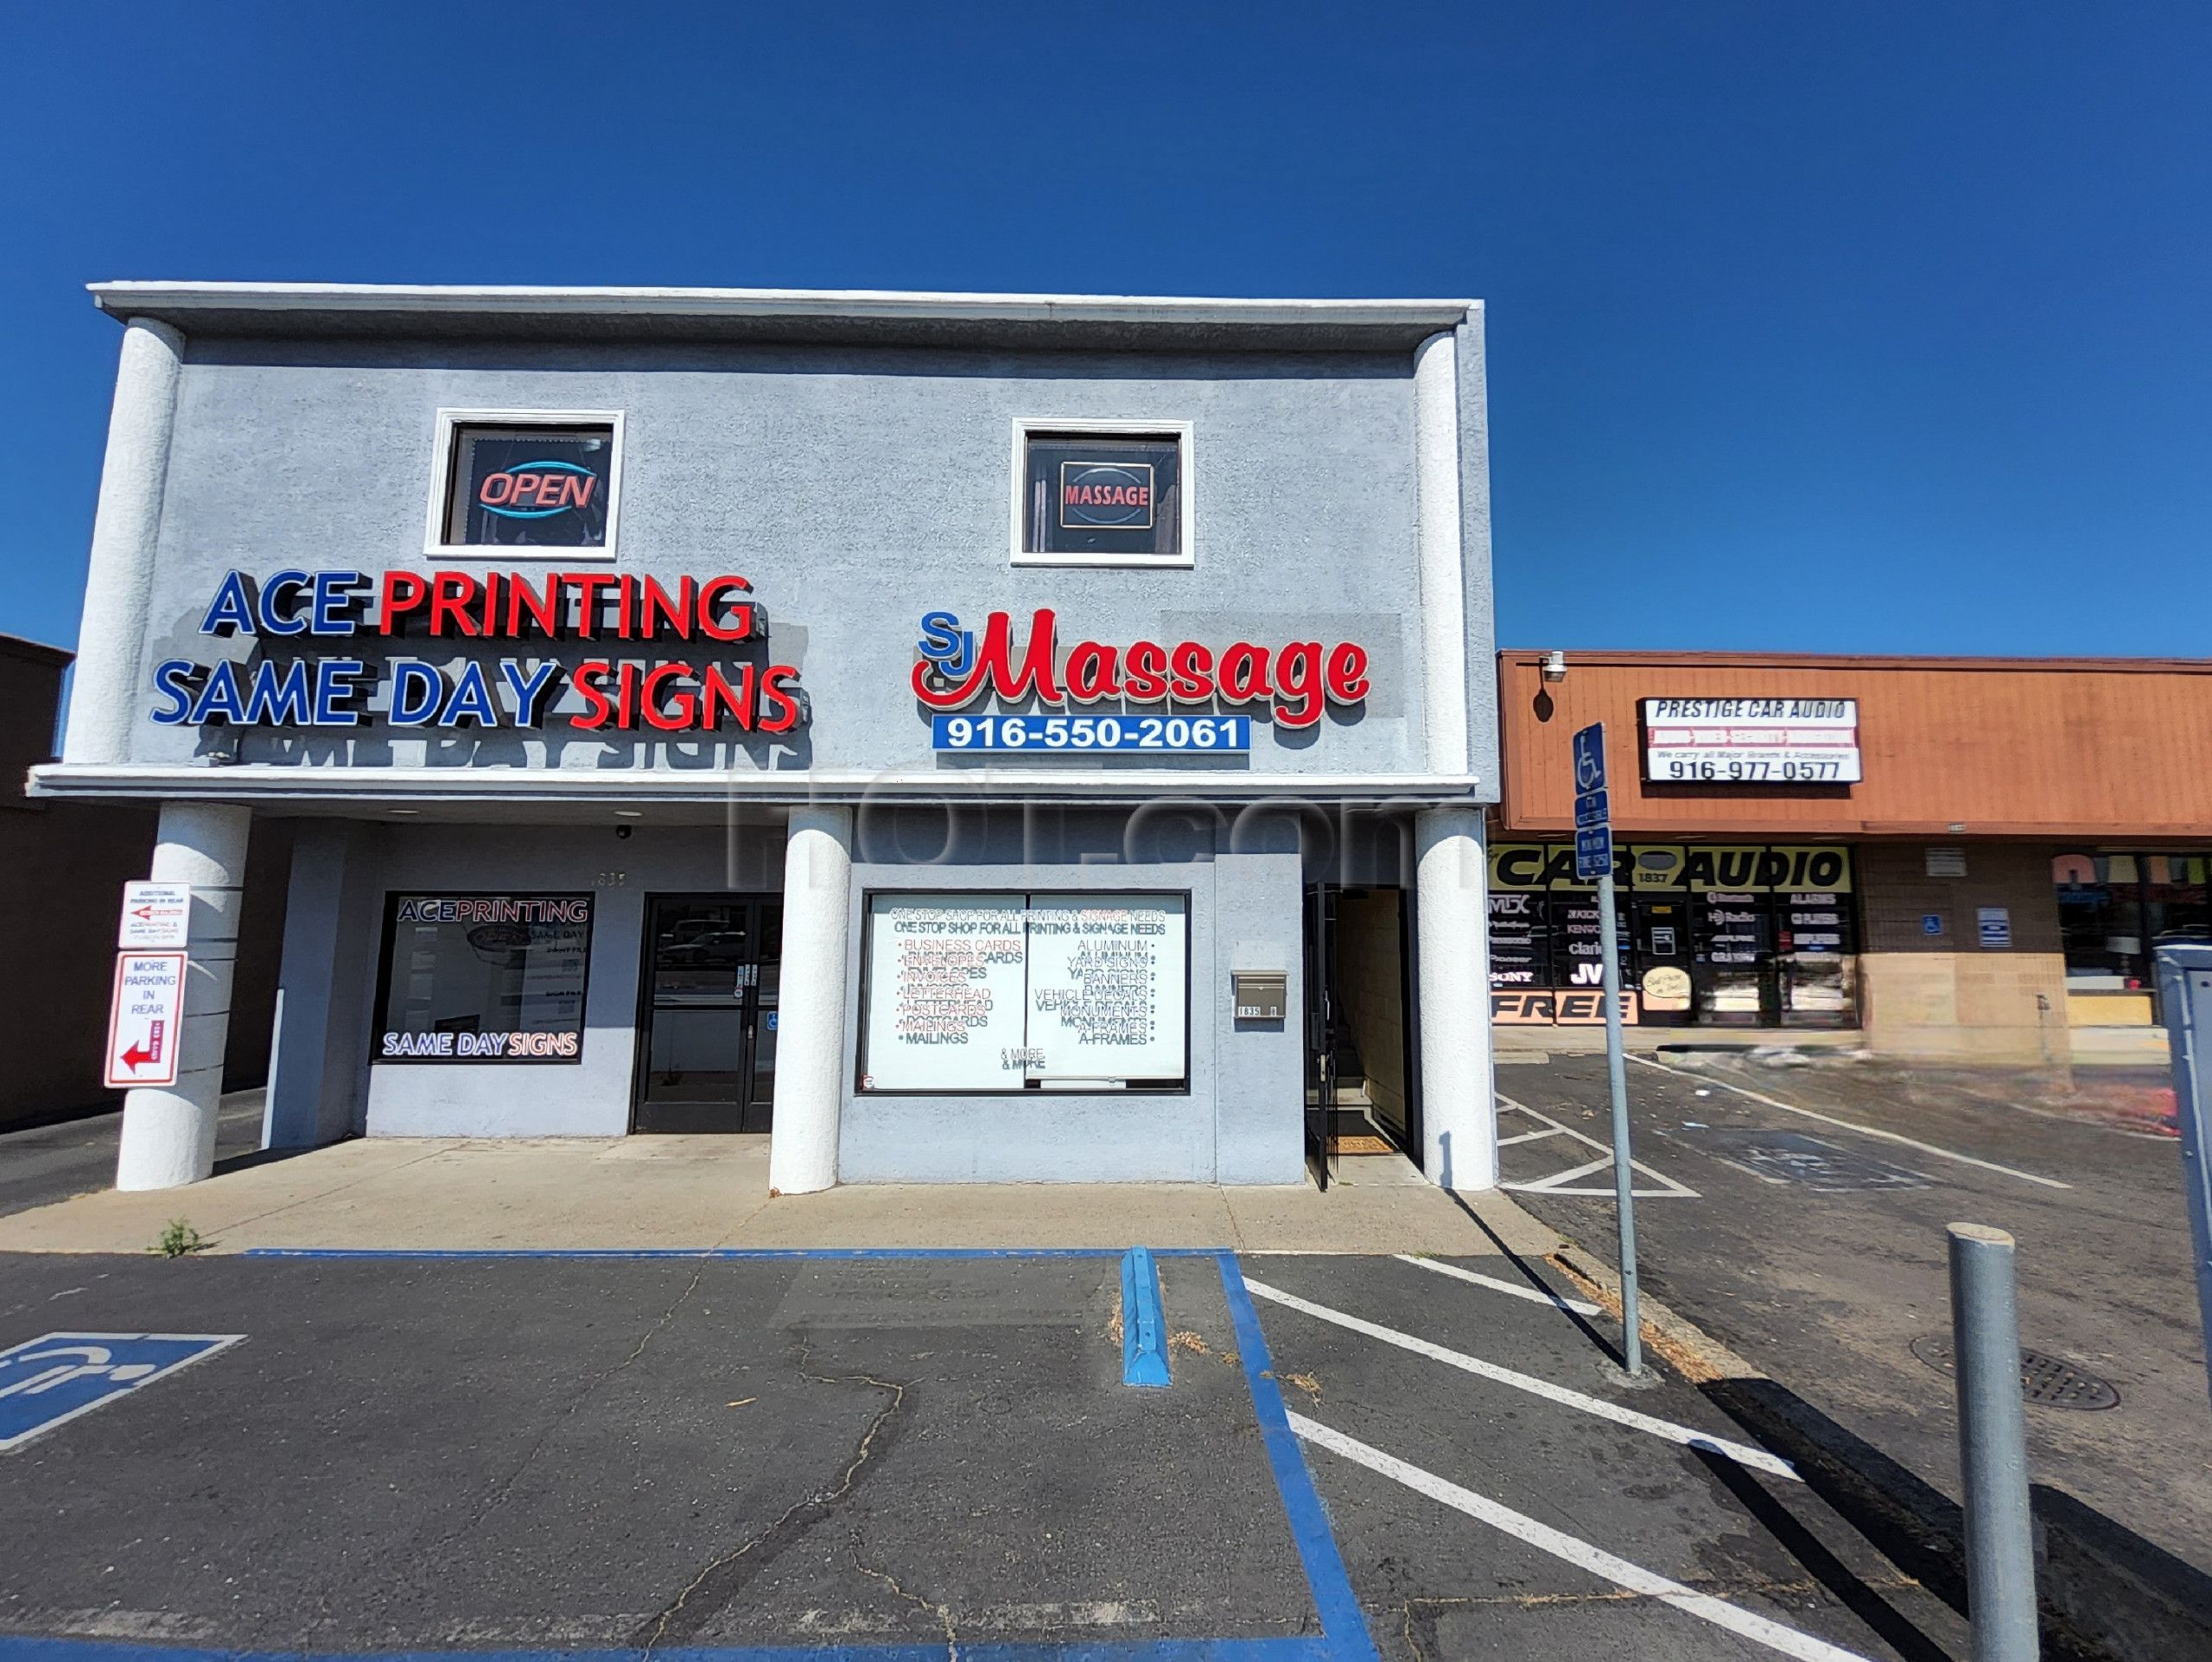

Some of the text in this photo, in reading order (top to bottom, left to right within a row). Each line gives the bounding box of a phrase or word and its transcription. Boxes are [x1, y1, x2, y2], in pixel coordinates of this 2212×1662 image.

[480, 473, 595, 509] OPEN
[1065, 485, 1149, 506] MASSAGE
[200, 569, 753, 641] ACE PRINTING
[918, 611, 973, 678] SJ
[911, 608, 1371, 728] Massage
[150, 659, 798, 732] SAME DAY SIGNS
[1656, 701, 1846, 718] PRESTIGE CAR AUDIO
[947, 717, 1239, 748] 916-550-2061
[1669, 761, 1840, 780] 916-977-0577
[1673, 849, 1843, 888] AUDIO
[1488, 894, 1531, 914] MTX
[1576, 909, 1600, 920] KICK
[1567, 924, 1602, 933] KENWO
[904, 939, 1021, 952] BUSINESS CARDS
[1077, 939, 1147, 951] ALUMINUM
[1568, 941, 1602, 955] Clari
[133, 961, 168, 971] MORE
[904, 954, 985, 966] ENVELOPES
[1067, 956, 1148, 968] YARD SIGNS
[903, 971, 967, 983] INVOICES
[1084, 973, 1148, 984] BANNERS
[1488, 971, 1535, 983] SONY
[1570, 963, 1605, 984] JV
[124, 975, 176, 985] PARKING
[143, 990, 155, 1000] IN
[903, 988, 991, 999] LETTERHEAD
[1034, 989, 1147, 1001] VEHICLE DECALS
[131, 1004, 163, 1015] REAR
[902, 1003, 986, 1016] POSTCARDS
[1061, 1005, 1148, 1017] MONUMENTS
[1239, 1006, 1260, 1016] 1835
[1491, 995, 1632, 1018] FREE
[901, 1020, 966, 1032] MAILINGS
[1077, 1022, 1148, 1034] A-FRAMES
[383, 1032, 577, 1056] SAME DAY SIGNS
[1011, 1048, 1045, 1060] MORE
